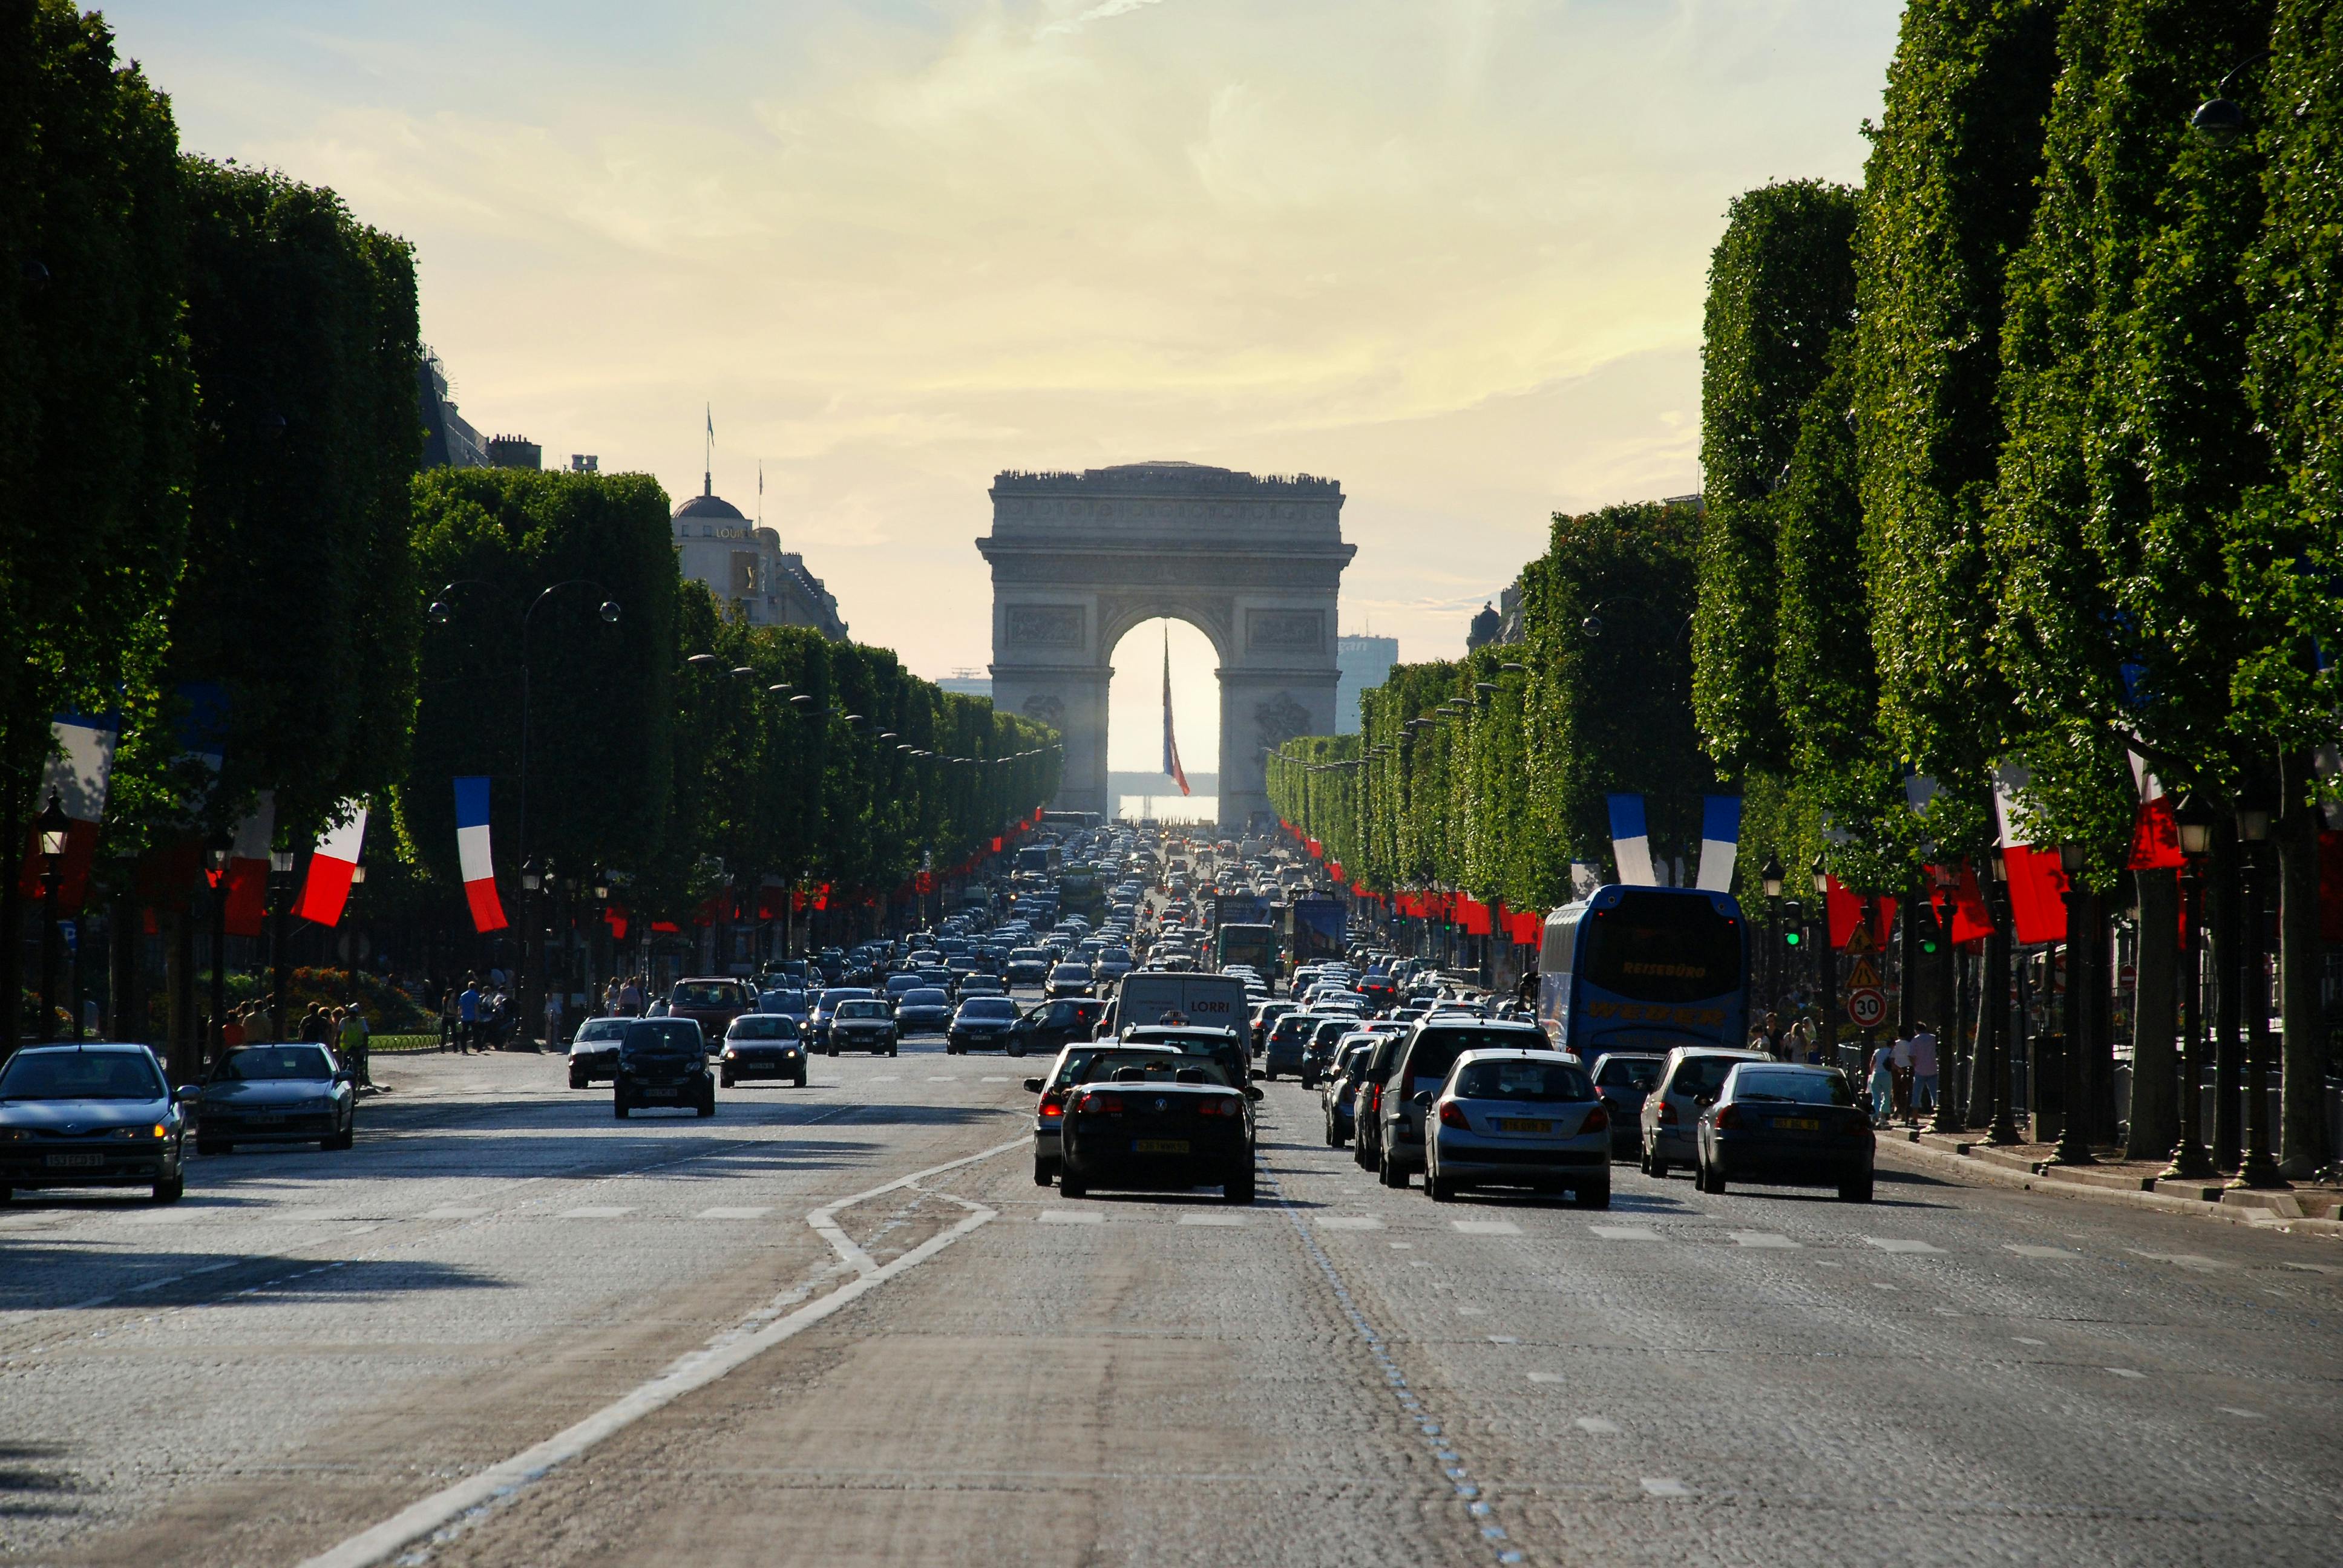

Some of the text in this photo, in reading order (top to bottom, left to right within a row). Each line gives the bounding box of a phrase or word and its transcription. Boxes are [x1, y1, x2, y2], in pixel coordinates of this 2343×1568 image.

[1622, 962, 1706, 978] REISEBÜRO
[1191, 1001, 1230, 1013] LORRI
[1588, 1001, 1727, 1027] WEBER
[1856, 999, 1879, 1015] 30
